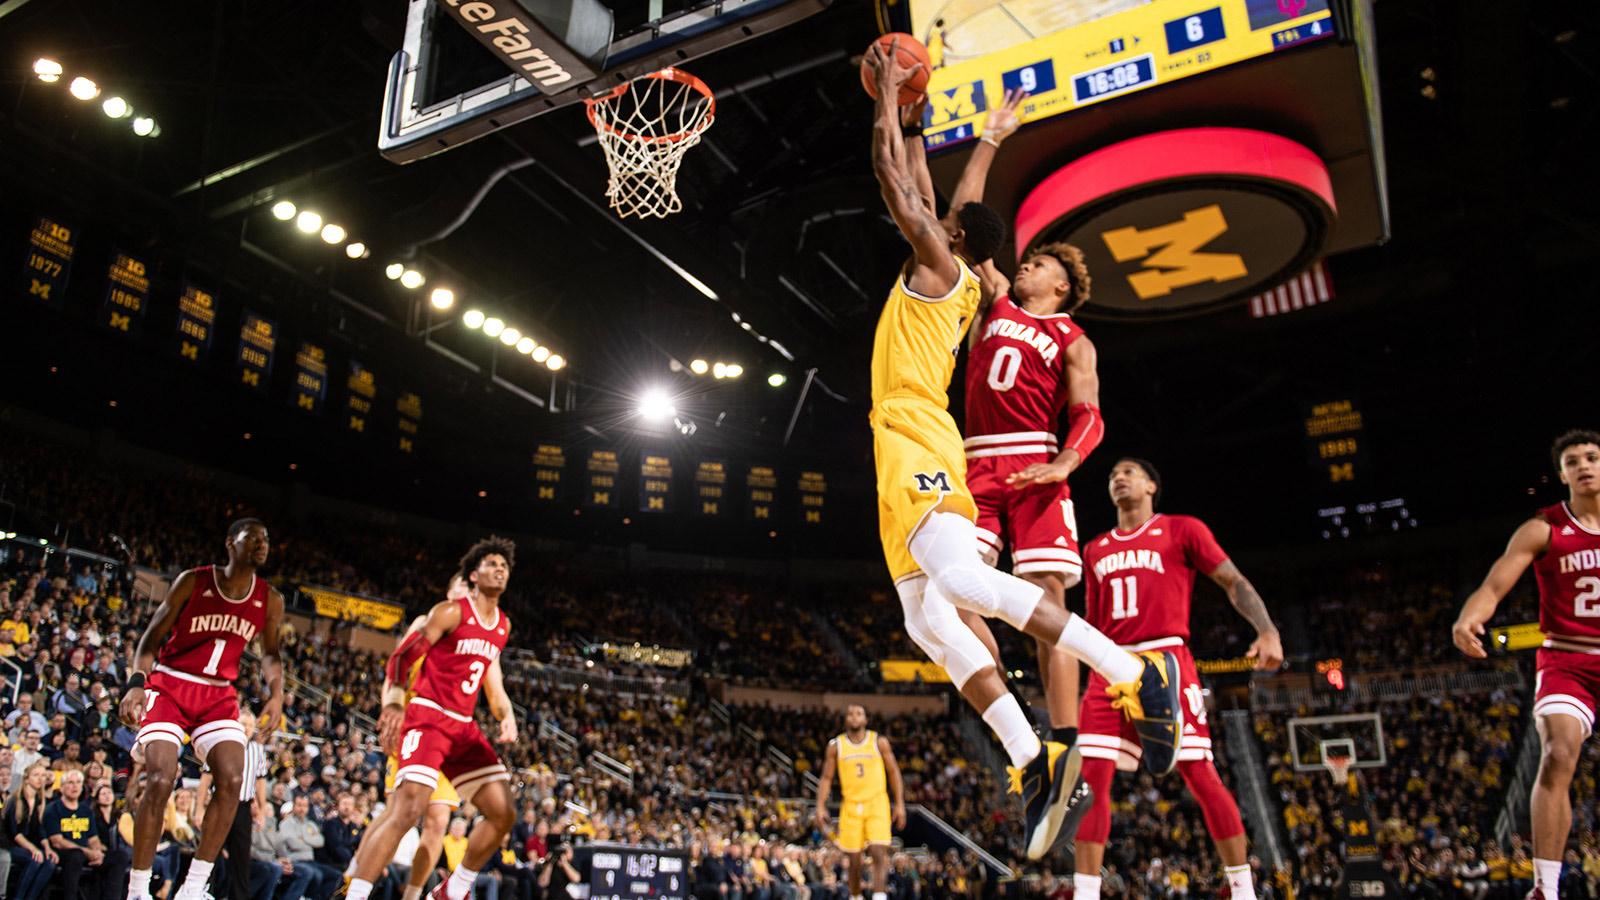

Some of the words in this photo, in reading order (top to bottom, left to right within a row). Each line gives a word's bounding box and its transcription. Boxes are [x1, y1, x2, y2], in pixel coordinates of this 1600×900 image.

[1184, 15, 1204, 42] 6
[1311, 20, 1322, 36] 4
[1019, 66, 1037, 92] 9
[1086, 62, 1140, 96] 16:02
[928, 82, 977, 127] M
[956, 126, 966, 139] 4
[1101, 204, 1248, 301] M
[29, 252, 63, 279] 1977
[29, 278, 51, 301] M
[109, 311, 131, 332] M
[180, 340, 199, 361] M
[241, 367, 259, 387] M
[987, 346, 1022, 392] 0
[296, 392, 315, 411] M
[349, 415, 366, 433] M
[914, 471, 951, 492] M
[1329, 462, 1355, 482] M
[538, 485, 556, 500] M
[593, 491, 610, 505] M
[648, 496, 665, 510] M
[703, 501, 719, 515] M
[754, 505, 769, 519] M
[805, 509, 821, 523] M
[1110, 575, 1139, 620] 11
[1574, 576, 1600, 618] 2
[203, 638, 227, 676] 1
[455, 638, 501, 661] INDIAN
[461, 661, 486, 695] 3
[855, 762, 865, 778] 3
[1347, 818, 1370, 837] M
[606, 869, 616, 888] 9
